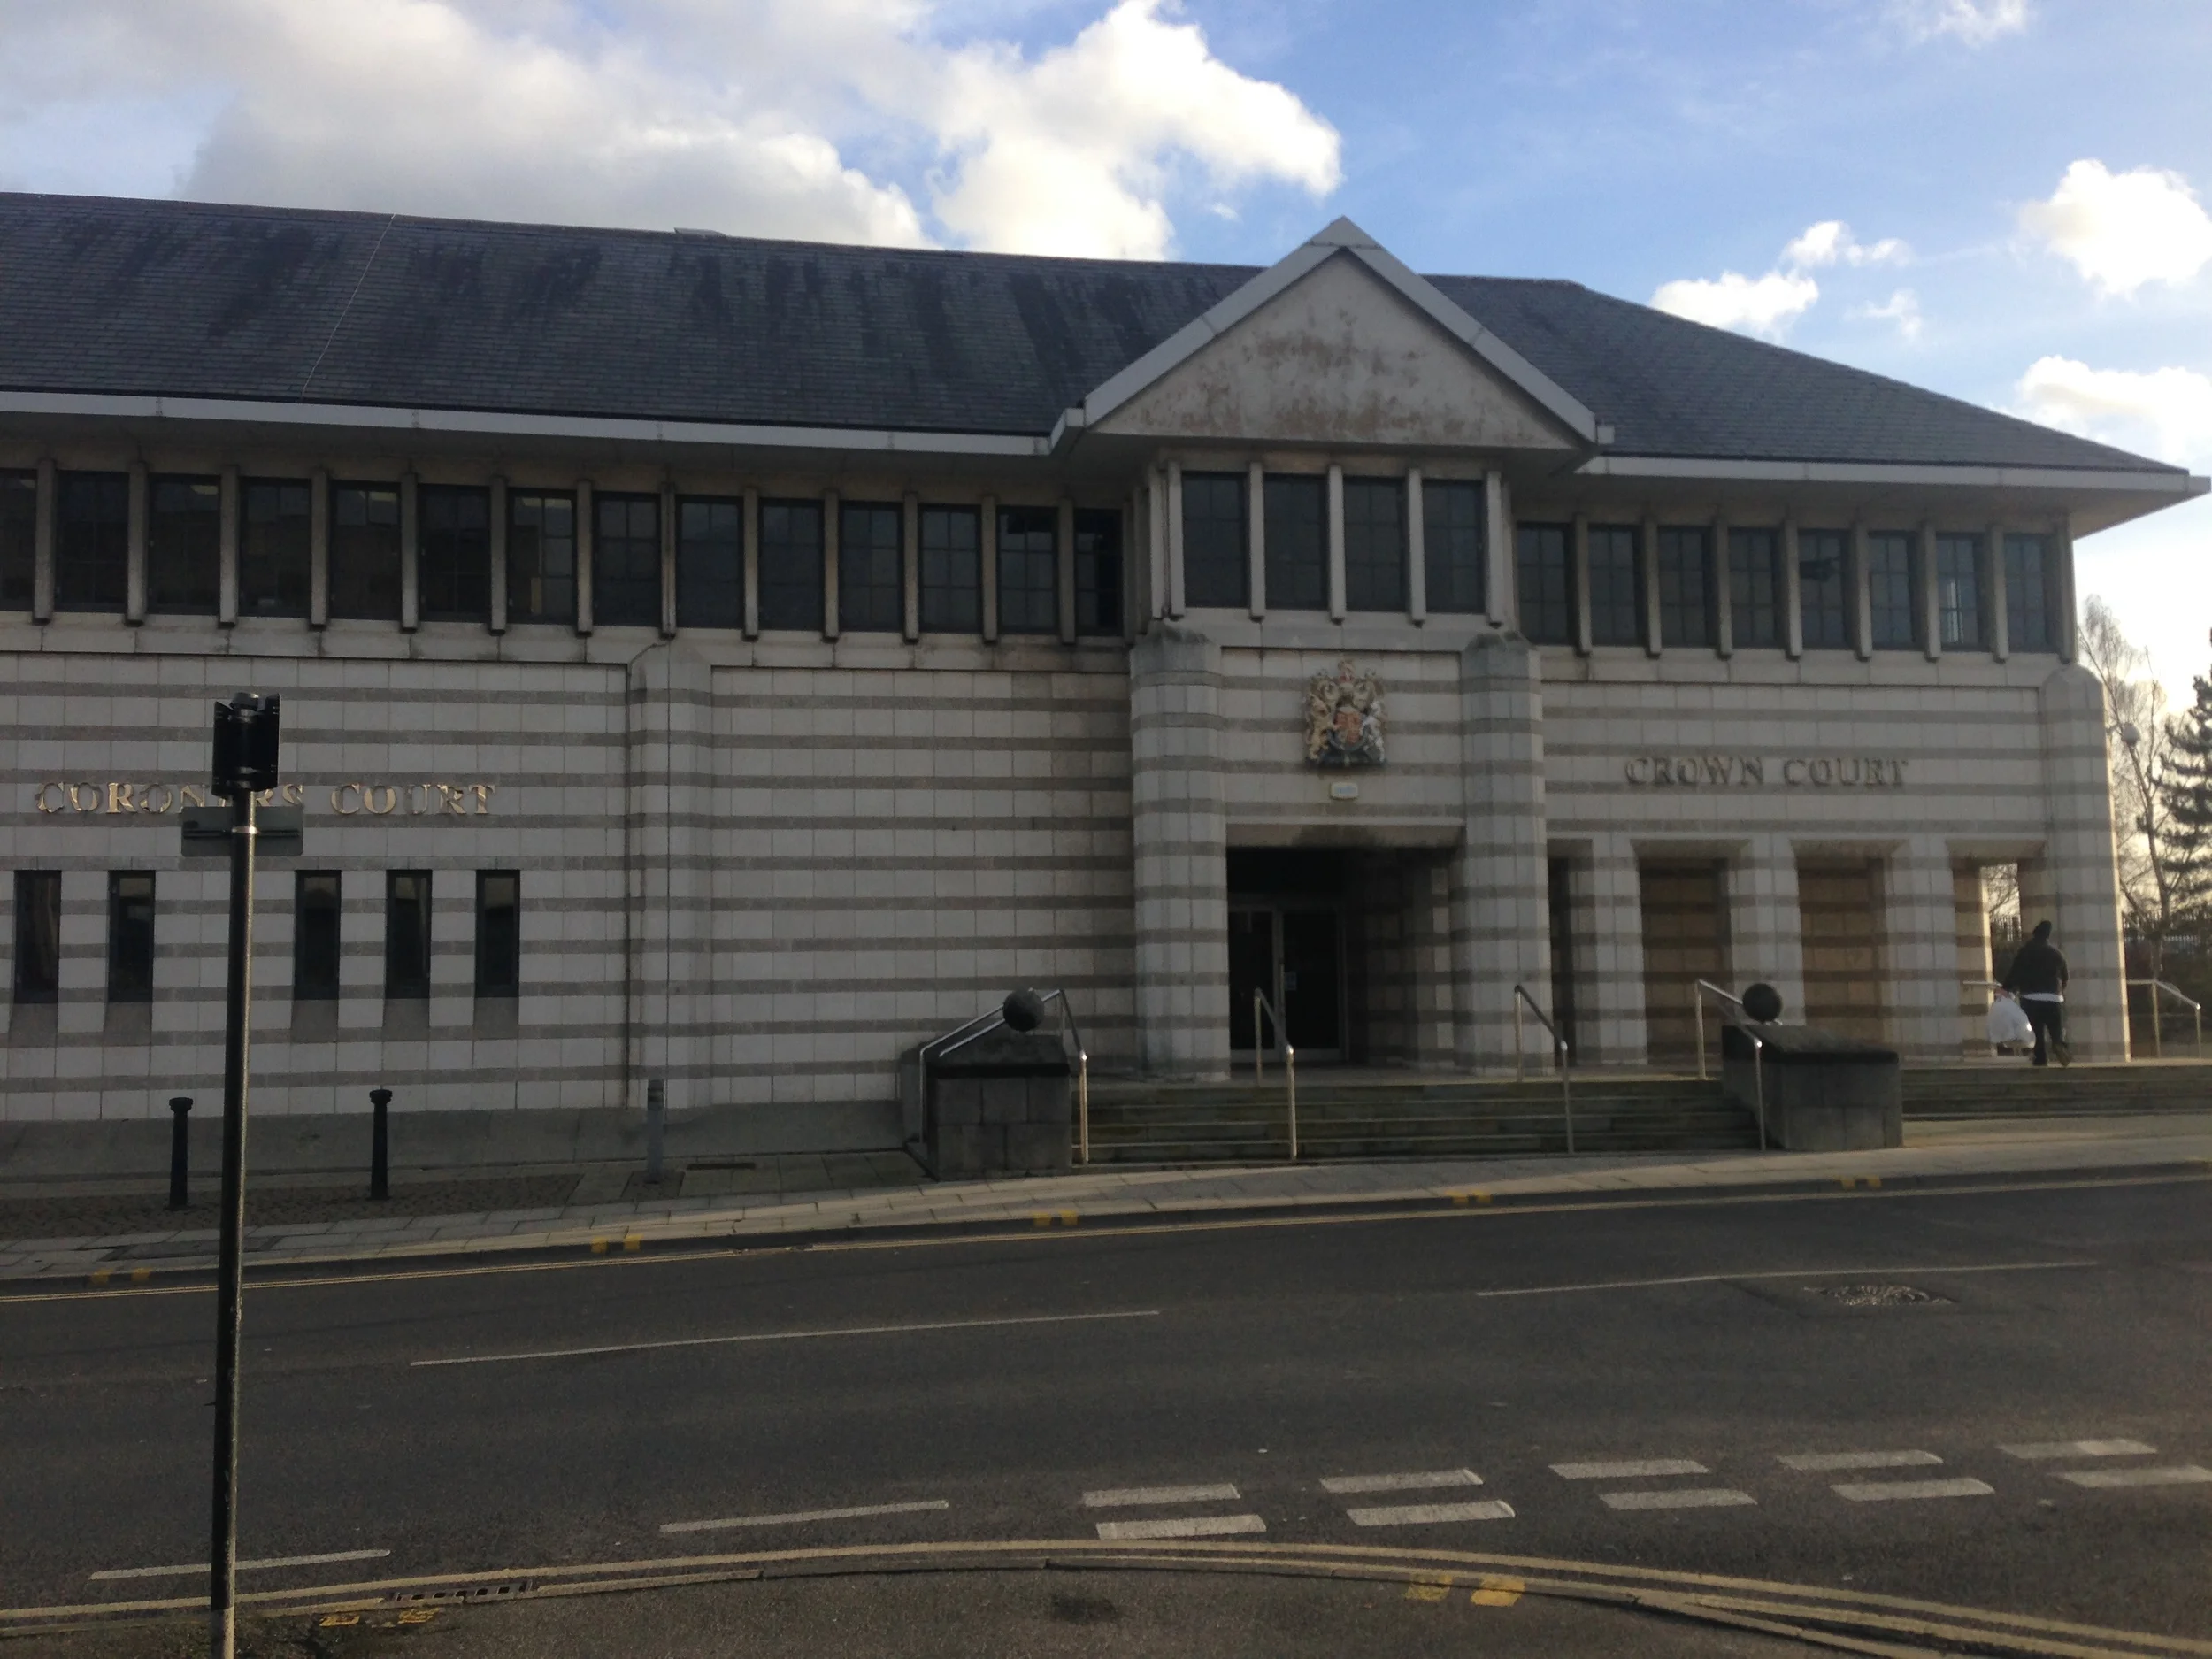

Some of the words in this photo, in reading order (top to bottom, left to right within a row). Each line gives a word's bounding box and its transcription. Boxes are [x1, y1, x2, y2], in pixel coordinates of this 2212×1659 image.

[1624, 757, 1764, 787] CROWN
[1782, 757, 1909, 787] COURT
[35, 781, 303, 814] CORONS
[330, 782, 496, 814] COURT
